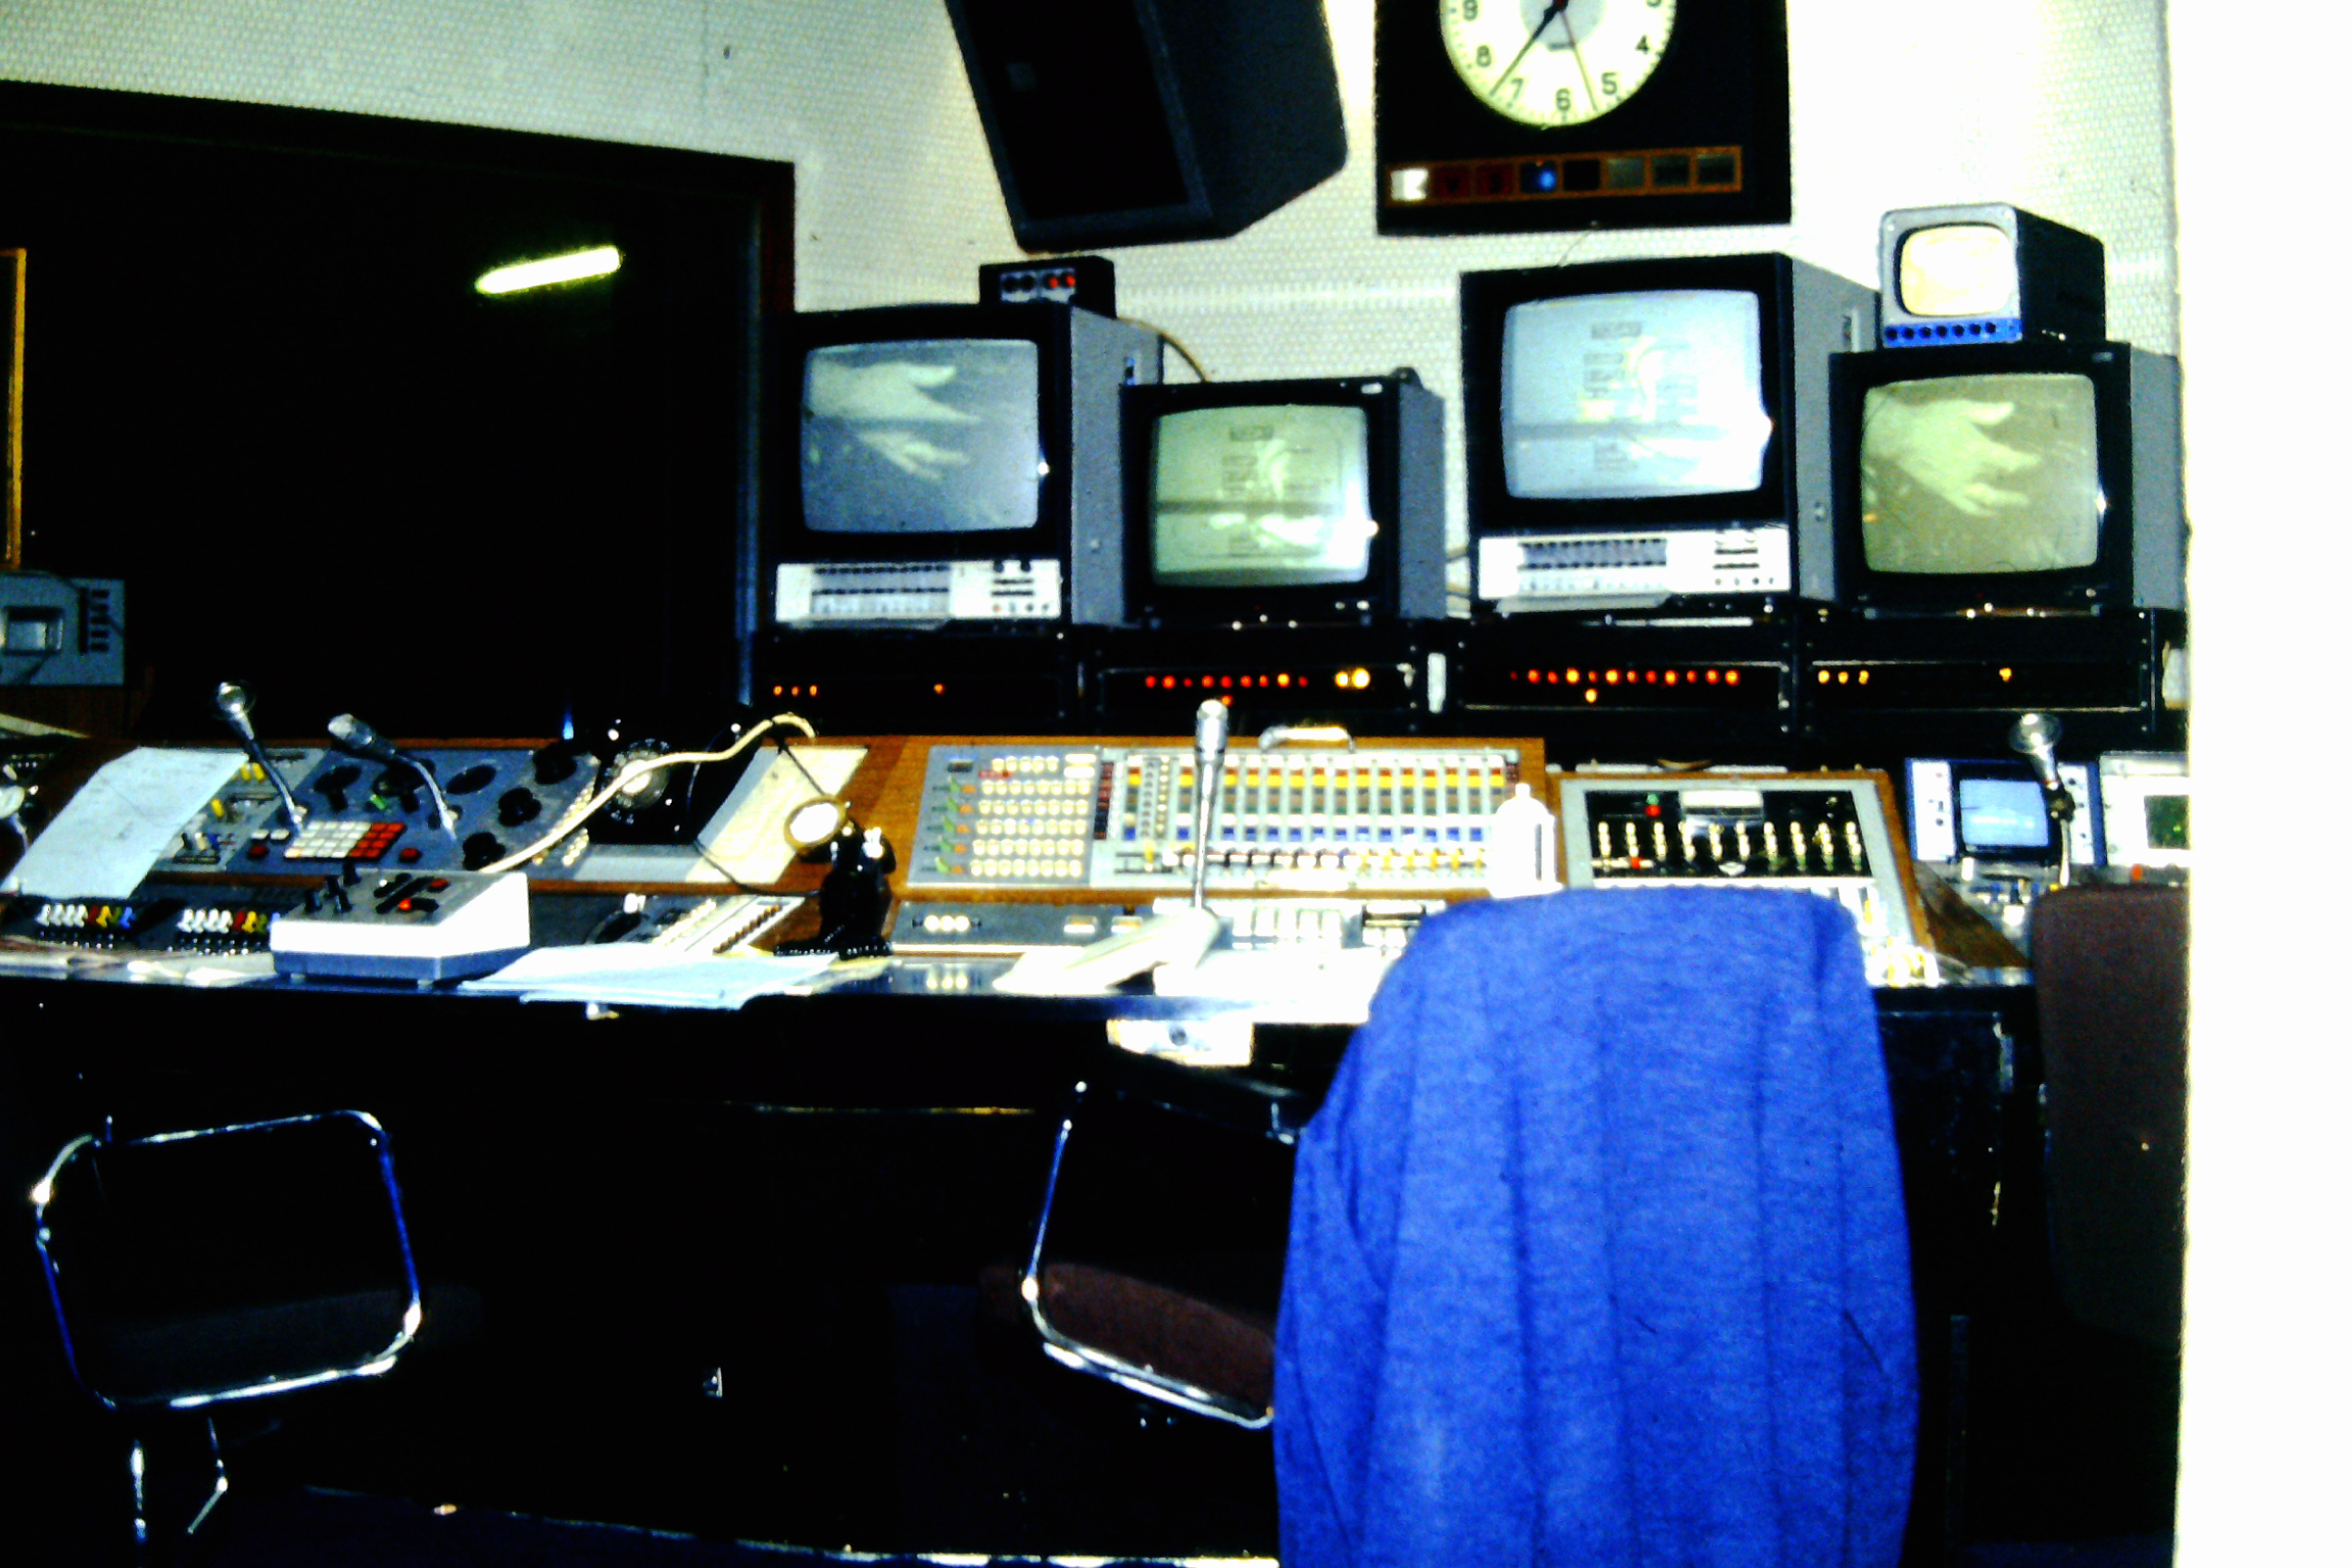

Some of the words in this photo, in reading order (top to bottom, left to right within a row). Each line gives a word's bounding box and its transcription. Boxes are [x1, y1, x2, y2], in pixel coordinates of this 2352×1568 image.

[1462, 0, 1478, 21] 9
[1475, 44, 1492, 68] 8
[1634, 34, 1650, 55] 4
[1510, 77, 1524, 101] 7
[1601, 72, 1618, 95] 5
[1555, 87, 1571, 112] 6
